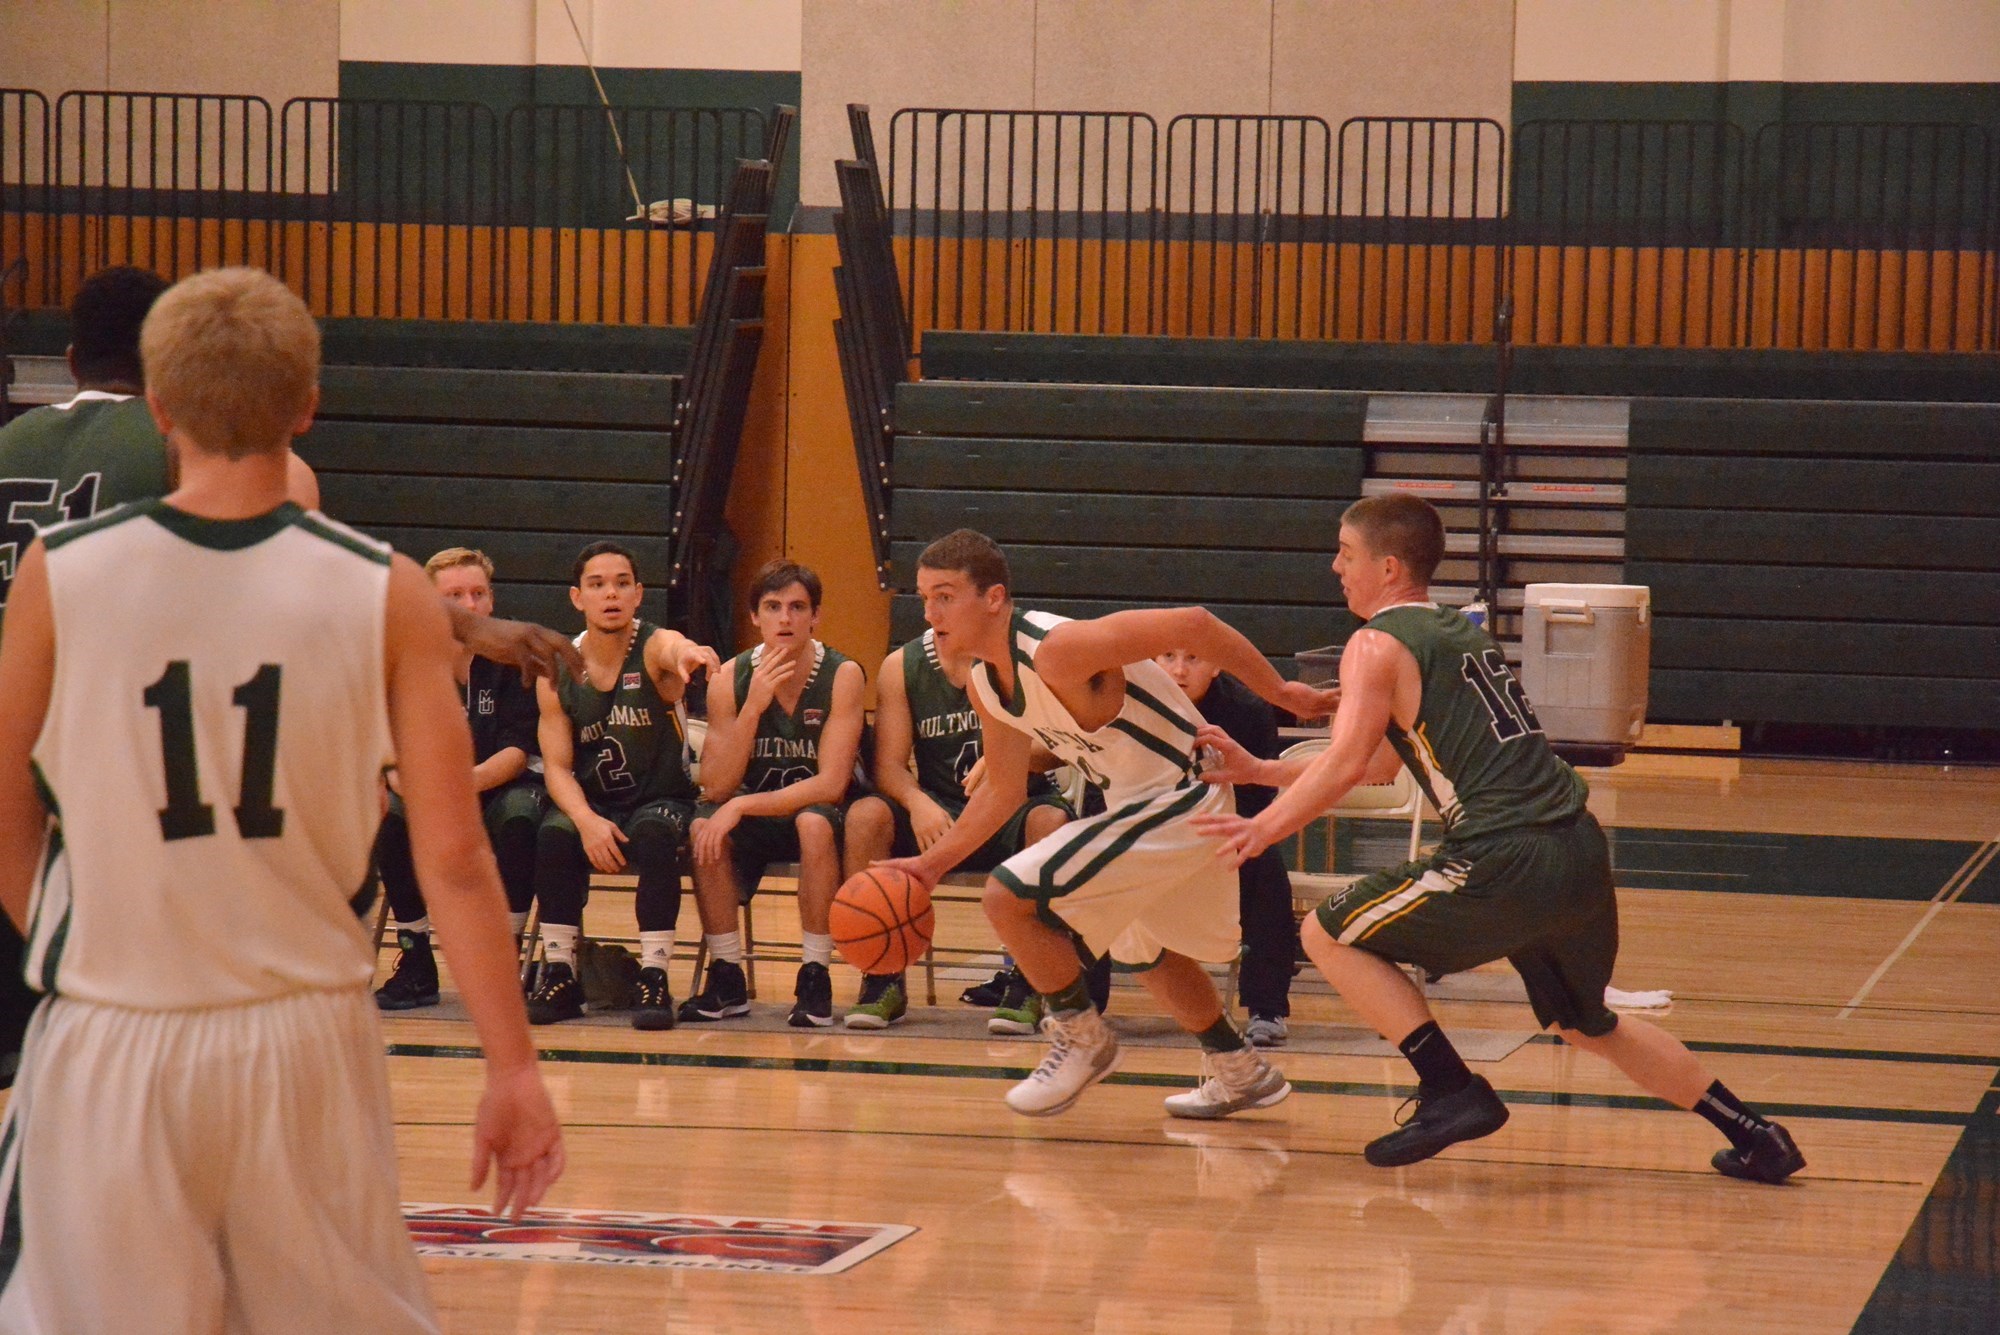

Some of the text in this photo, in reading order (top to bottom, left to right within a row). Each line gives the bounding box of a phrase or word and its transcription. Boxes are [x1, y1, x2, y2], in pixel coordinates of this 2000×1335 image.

[1461, 648, 1544, 743] 12
[142, 659, 285, 842] 11
[595, 735, 637, 792] 2
[401, 1206, 886, 1235] ASCADE
